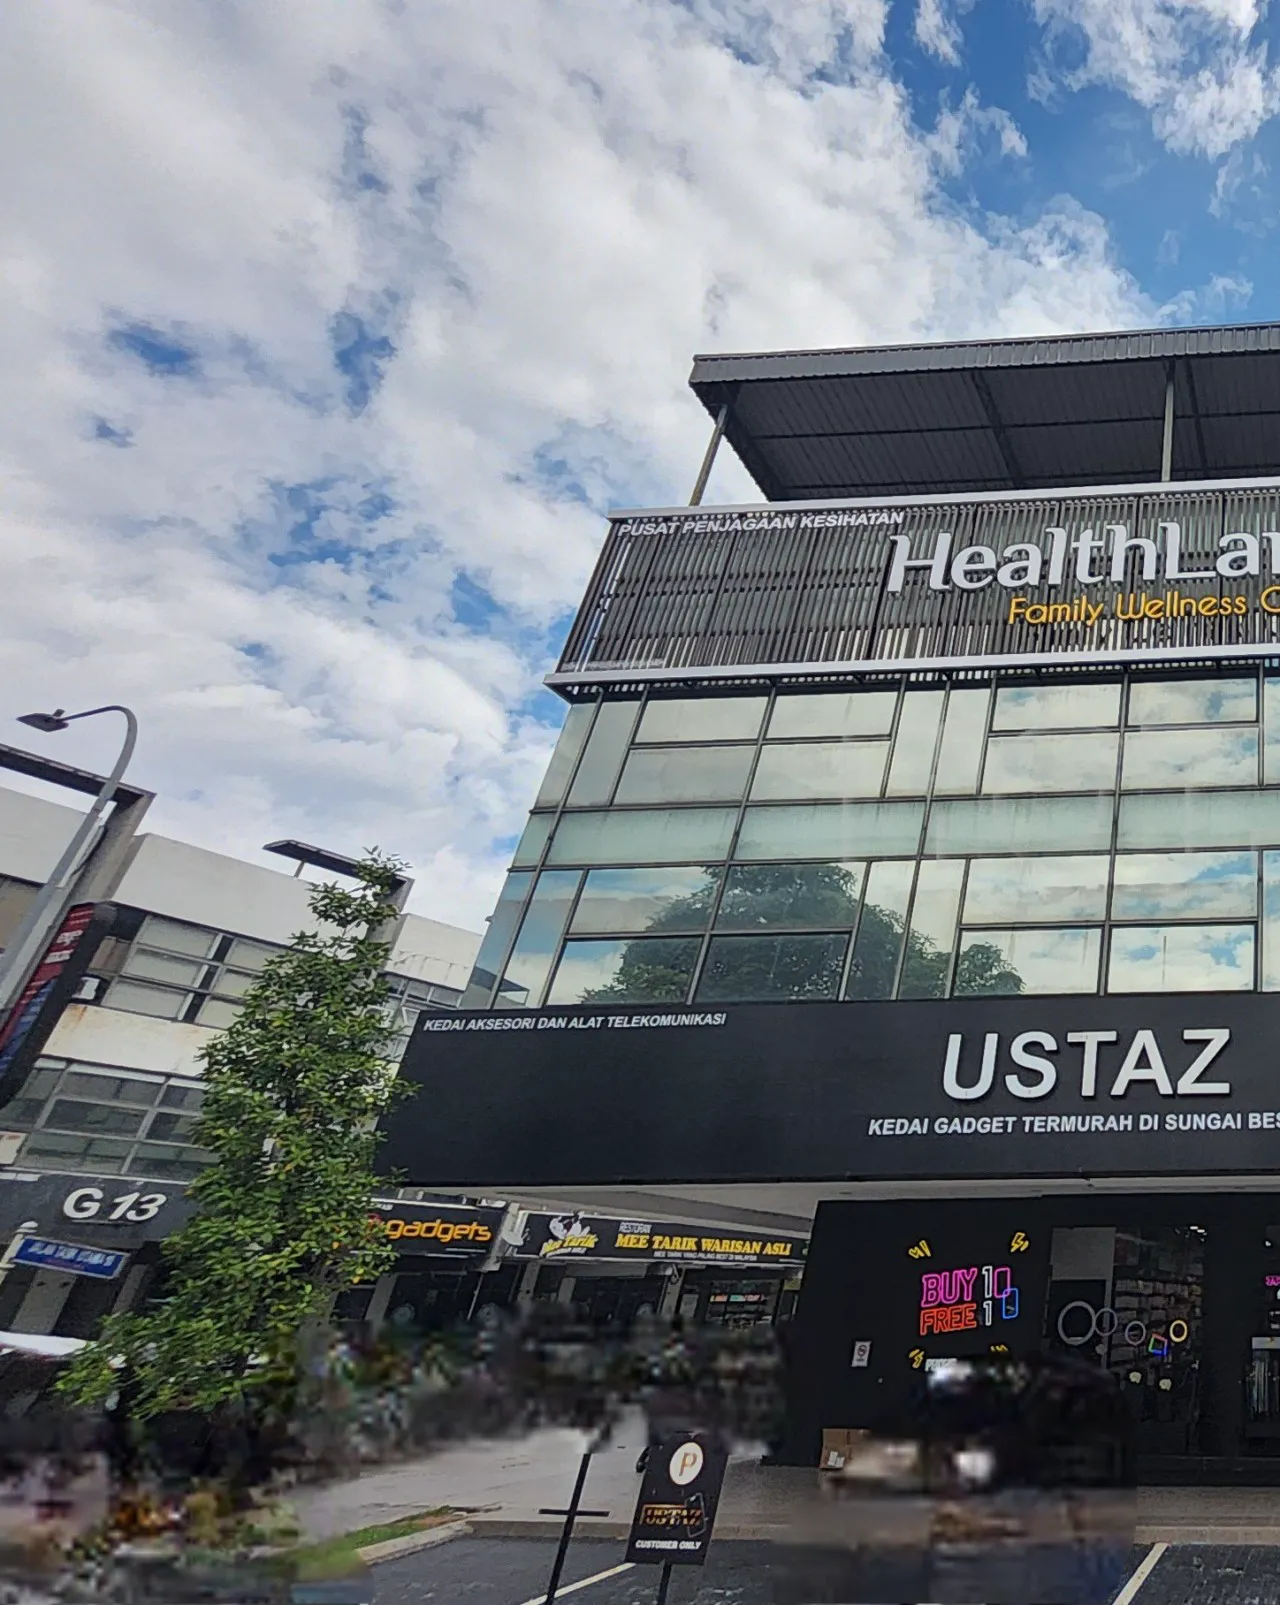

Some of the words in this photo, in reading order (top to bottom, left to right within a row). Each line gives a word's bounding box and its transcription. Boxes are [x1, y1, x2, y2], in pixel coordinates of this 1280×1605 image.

[617, 520, 680, 538] PUSAT
[682, 516, 797, 534] PENJAGAAN
[800, 511, 905, 529] KESIHATAN
[1008, 593, 1105, 627] Family
[1115, 590, 1248, 621] Wellness
[423, 1018, 466, 1032] KEDAI
[466, 1017, 537, 1031] AKSESORI
[537, 1016, 568, 1030] DAN
[568, 1015, 605, 1030] ALAT
[607, 1012, 727, 1029] TELEKOMUNIKASI
[941, 1027, 1232, 1101] USTAZ
[867, 1117, 929, 1136] KEDAI
[934, 1115, 1016, 1135] GADGET
[1022, 1114, 1132, 1133] TERMURAH
[1138, 1113, 1159, 1131] DI
[1164, 1112, 1243, 1131] SUNGAI
[614, 1233, 649, 1248] MEE
[652, 1235, 698, 1251] TARIK
[700, 1237, 763, 1255] WARISAN
[763, 1241, 793, 1256] ASLI
[920, 1267, 978, 1308] BUY
[982, 1265, 993, 1299] 1
[919, 1302, 978, 1336] FREE
[983, 1300, 992, 1326] 1
[679, 1452, 698, 1477] P
[635, 1539, 678, 1550] CUSTOMER
[679, 1540, 702, 1550] ONLY
